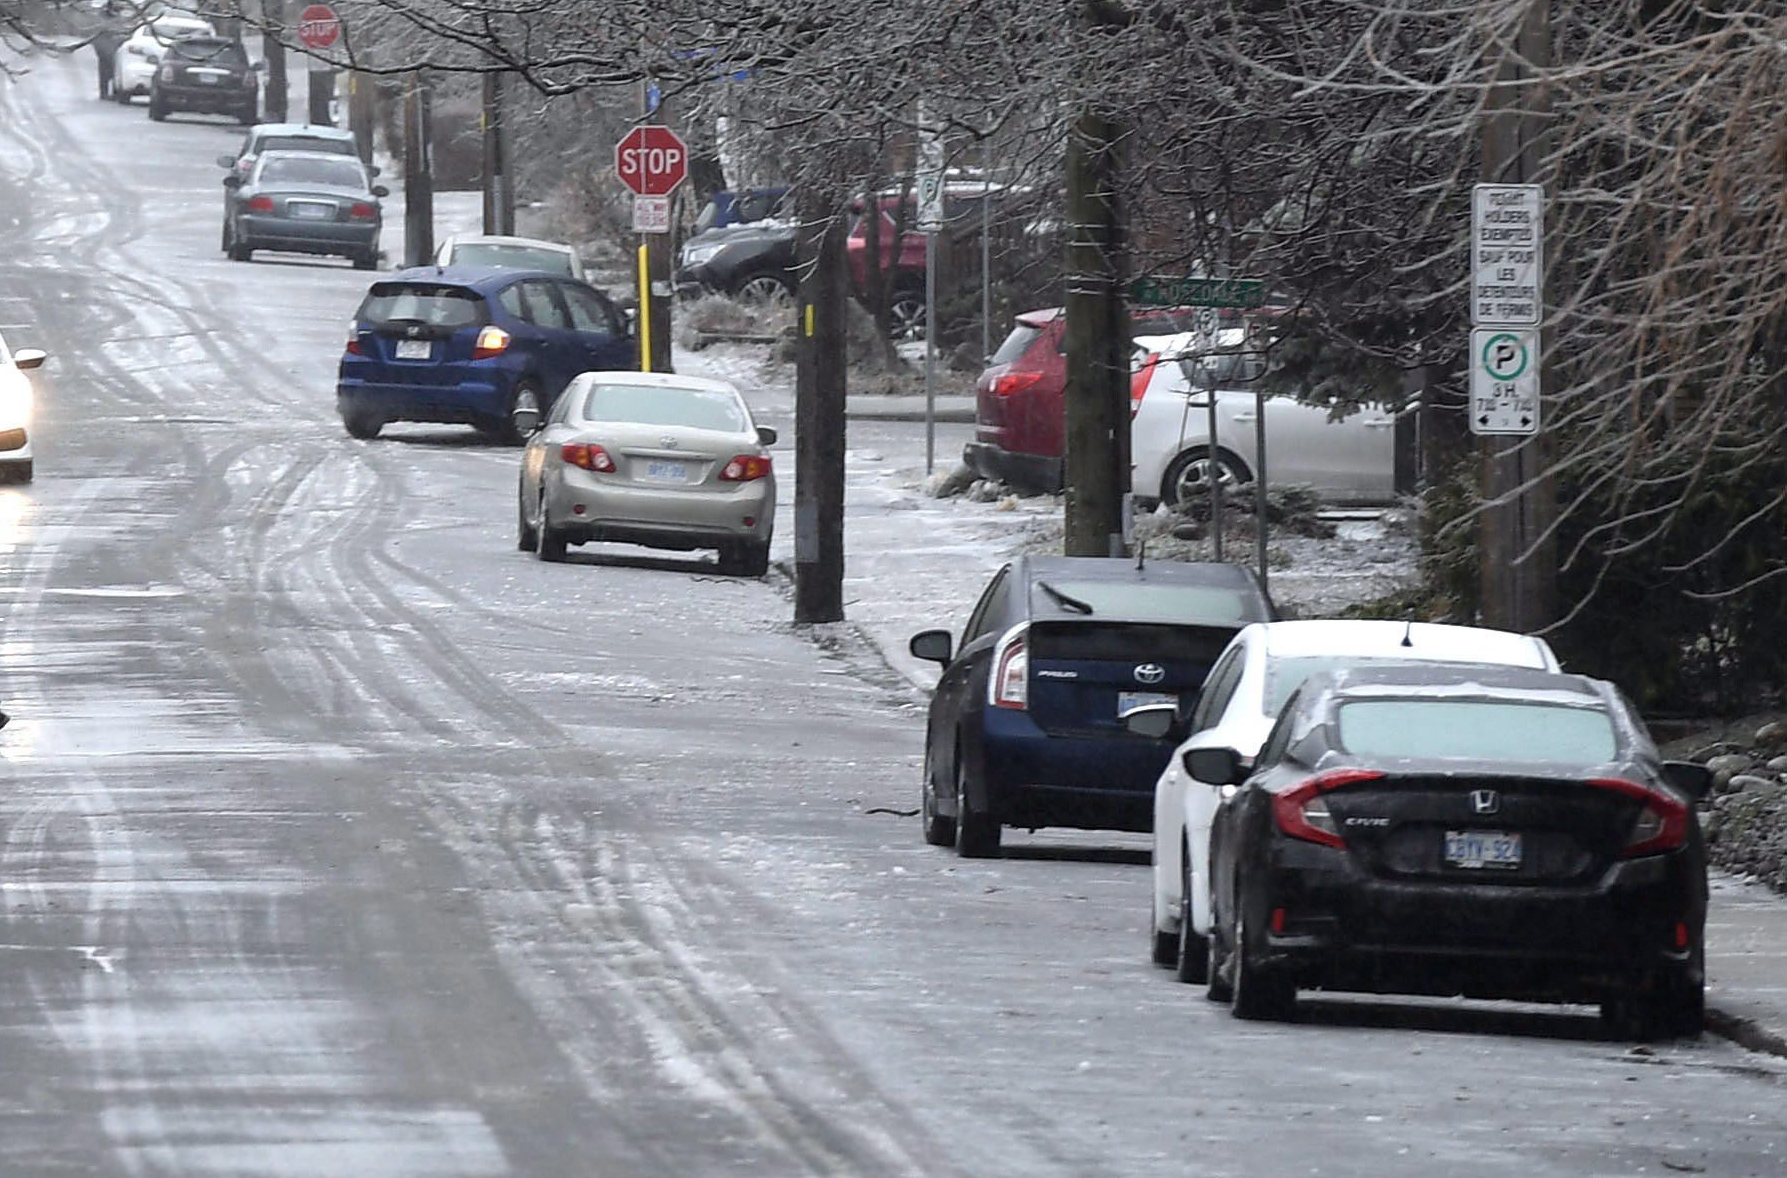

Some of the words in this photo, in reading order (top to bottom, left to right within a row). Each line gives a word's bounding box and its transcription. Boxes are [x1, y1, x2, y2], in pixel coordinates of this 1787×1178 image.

[300, 21, 333, 37] STOP
[621, 148, 681, 174] STOP
[1489, 193, 1525, 205] PERMIT
[1484, 210, 1530, 223] HOLDERS
[1481, 228, 1532, 241] EXEMPTED
[1479, 250, 1505, 263] SAUF
[1508, 250, 1534, 263] POUR
[1497, 268, 1515, 281] LES
[1479, 303, 1492, 315] DE
[1497, 303, 1532, 316] PERMIS
[1496, 344, 1515, 369] P
